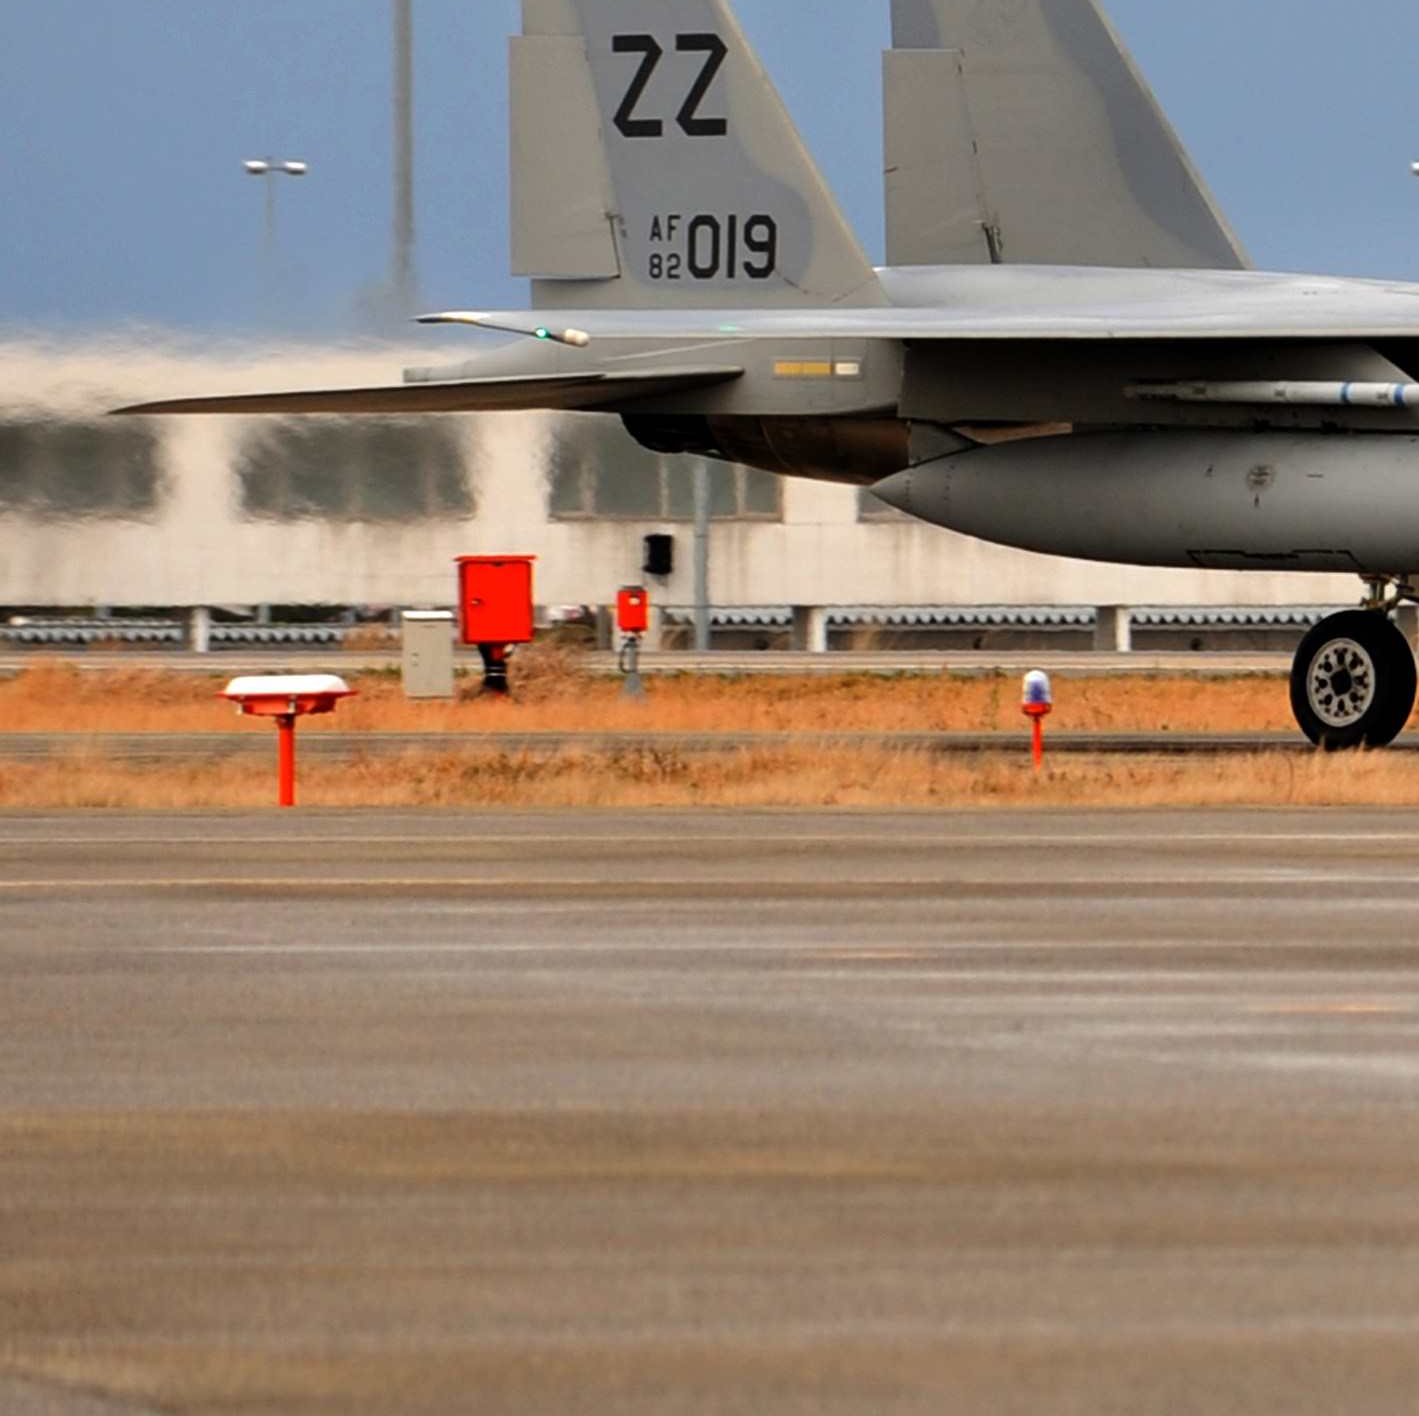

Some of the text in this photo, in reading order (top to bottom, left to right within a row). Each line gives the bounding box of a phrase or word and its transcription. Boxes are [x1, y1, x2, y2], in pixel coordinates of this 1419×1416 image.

[612, 33, 728, 138] ZZ
[649, 214, 777, 279] 82 019
[650, 214, 681, 241] AF
